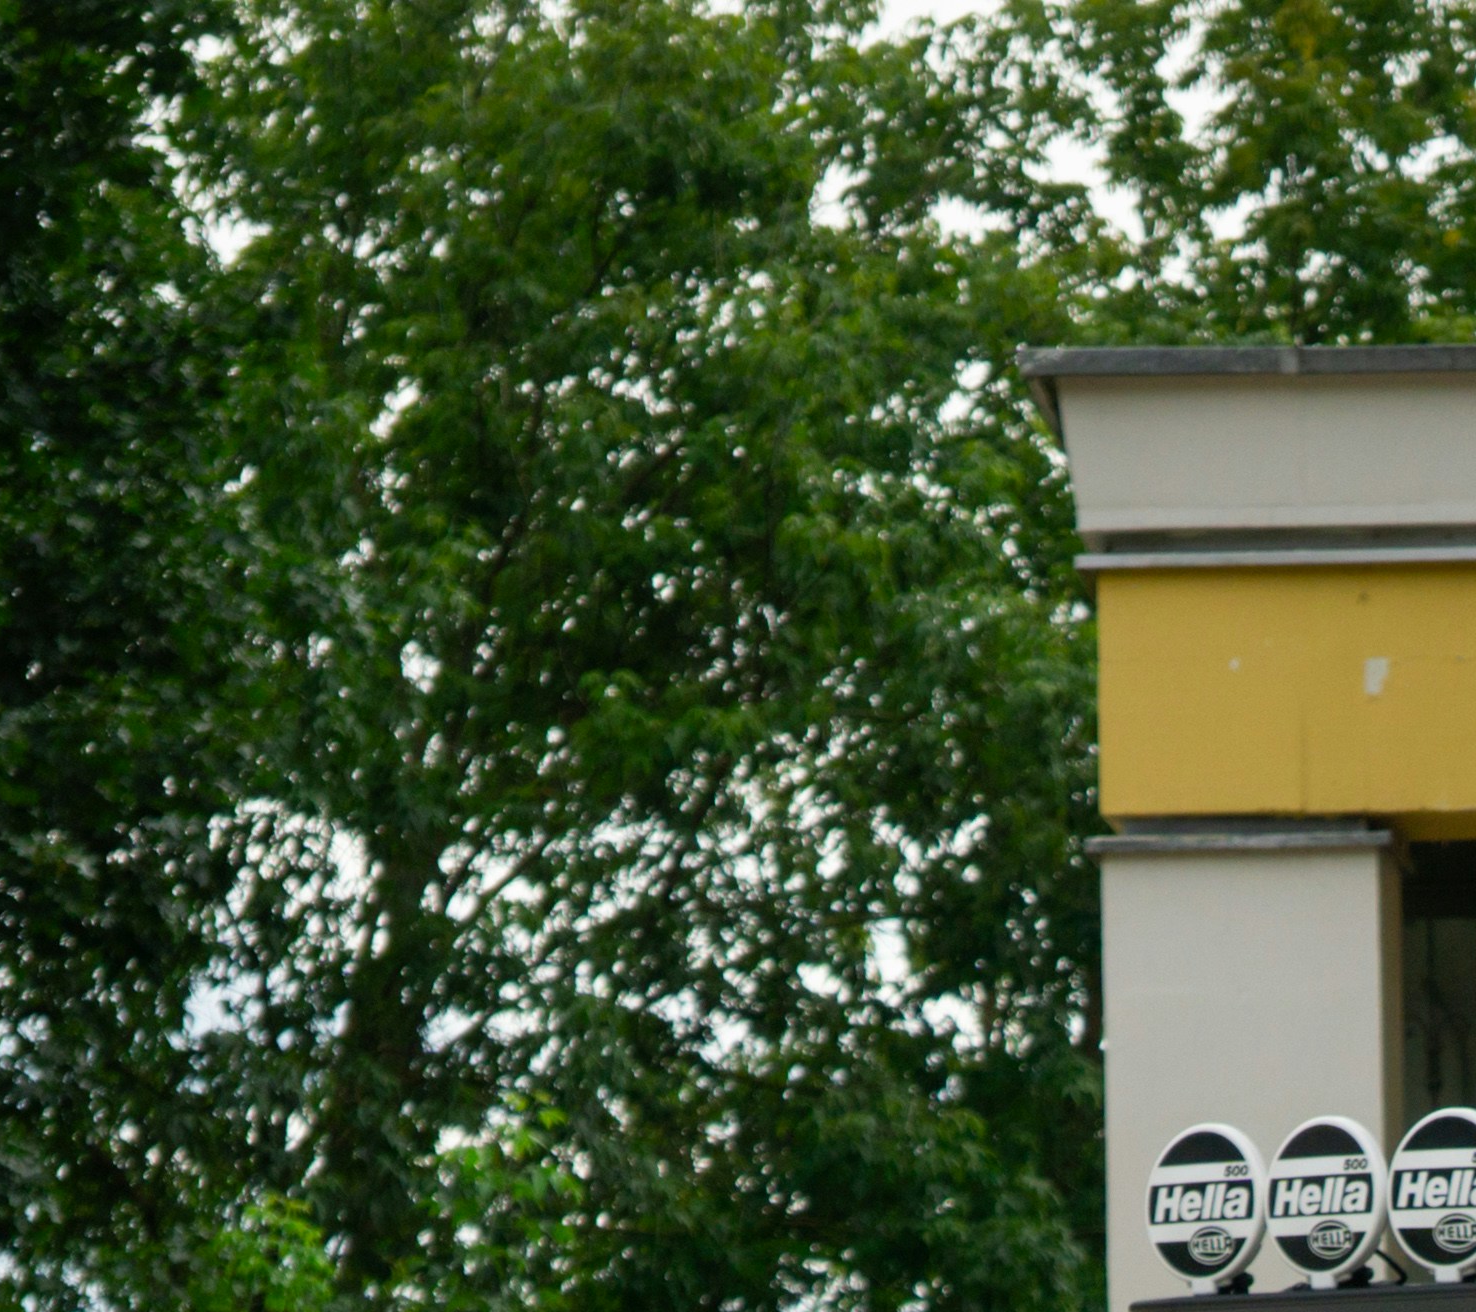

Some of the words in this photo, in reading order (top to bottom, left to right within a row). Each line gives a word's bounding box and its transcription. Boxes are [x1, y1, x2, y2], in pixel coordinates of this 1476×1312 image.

[1224, 1164, 1249, 1177] 500
[1343, 1158, 1369, 1170] 500
[1153, 1183, 1250, 1224] Hella
[1273, 1176, 1369, 1216] Hella
